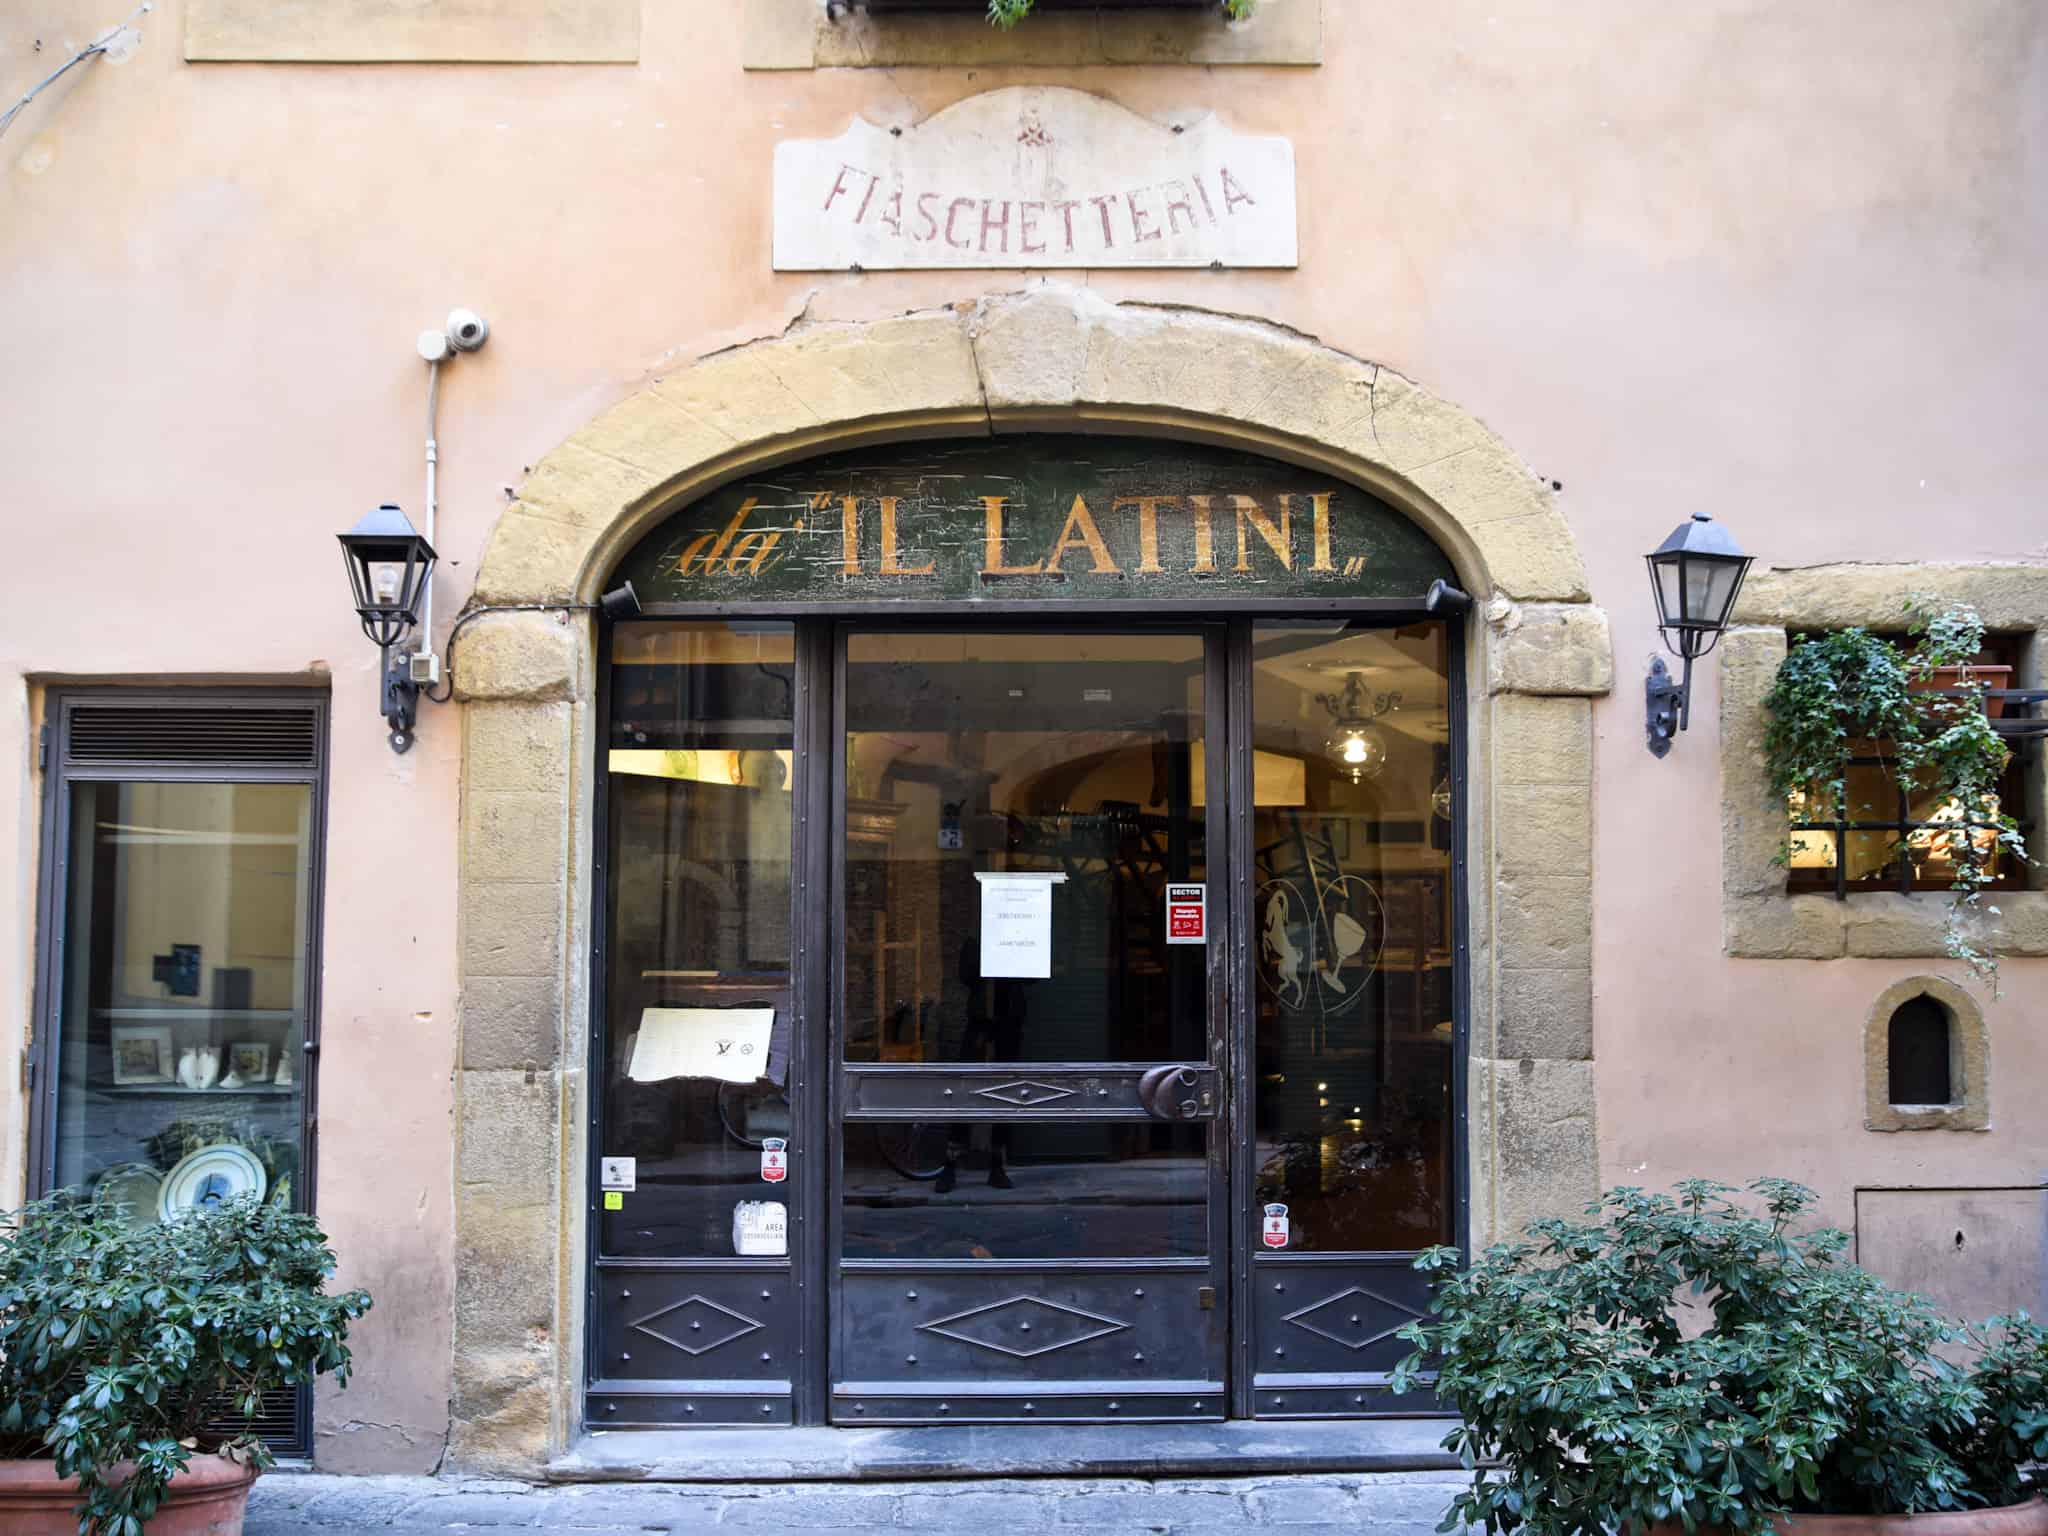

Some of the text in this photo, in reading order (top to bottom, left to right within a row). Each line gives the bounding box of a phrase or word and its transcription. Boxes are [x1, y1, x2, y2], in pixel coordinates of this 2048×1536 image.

[823, 163, 1257, 253] FIASCHETTERIA
[664, 496, 785, 577] da
[1171, 888, 1201, 896] SECTOR
[765, 1223, 784, 1232] AREA
